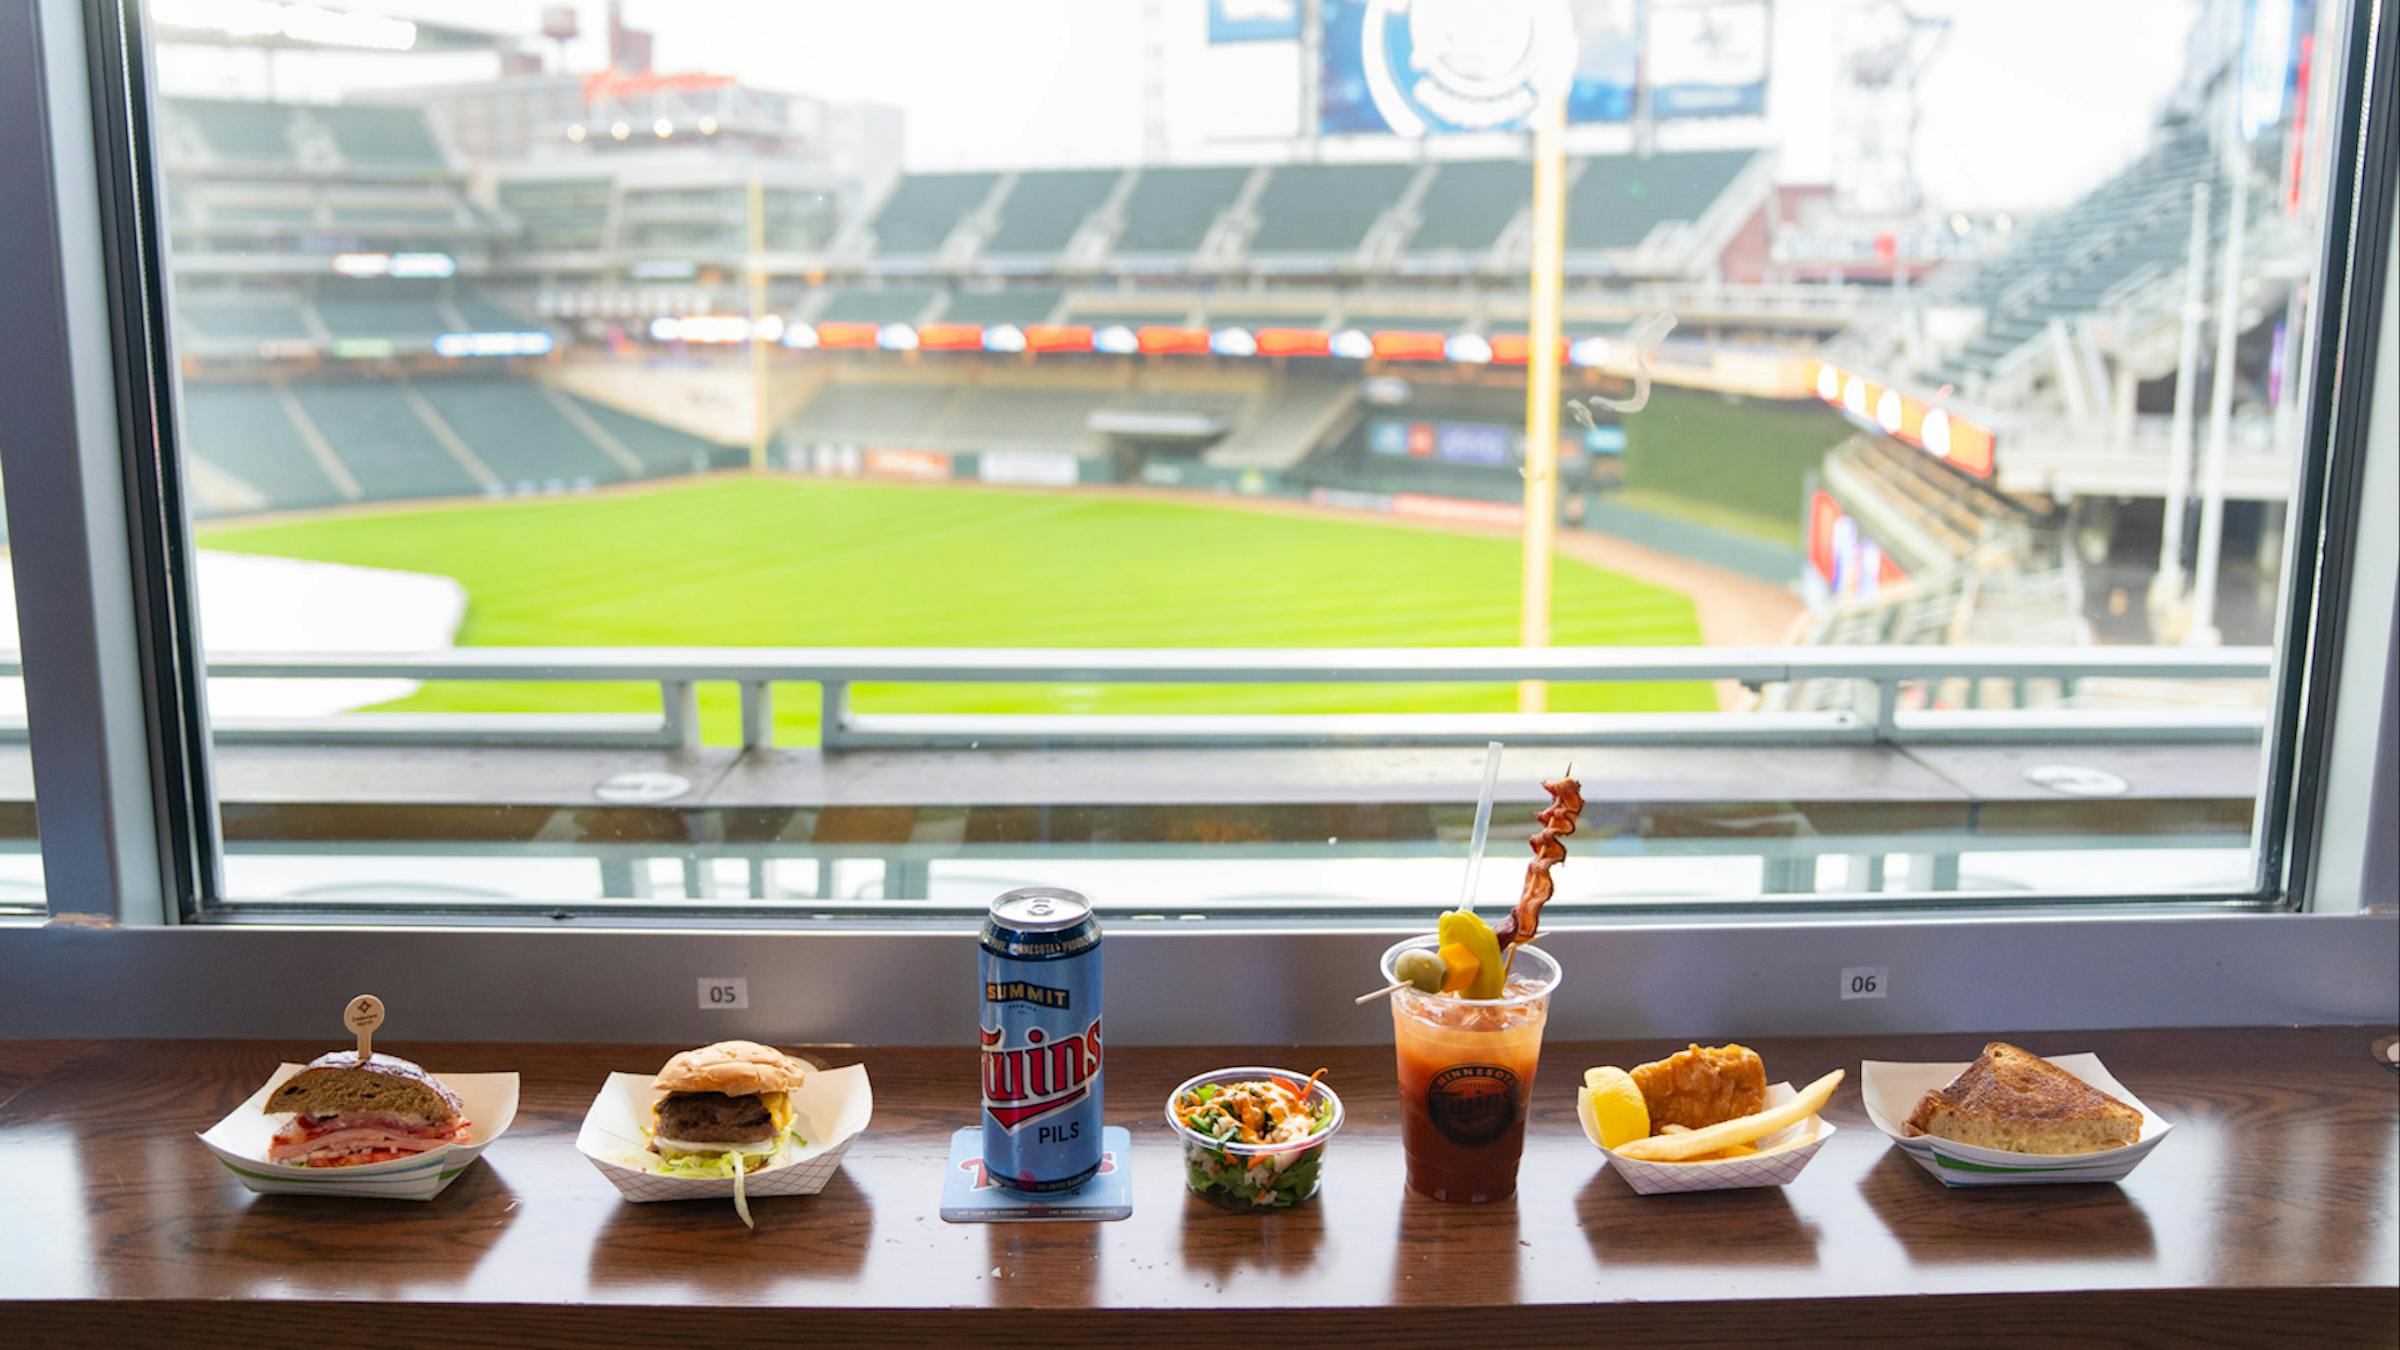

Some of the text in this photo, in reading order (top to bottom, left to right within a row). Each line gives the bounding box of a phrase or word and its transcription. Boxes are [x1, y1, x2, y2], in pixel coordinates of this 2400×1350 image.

[710, 986, 736, 1003] 05
[986, 982, 1067, 1007] SUMMIT
[1851, 975, 1876, 993] 06
[1038, 1121, 1080, 1145] PILS
